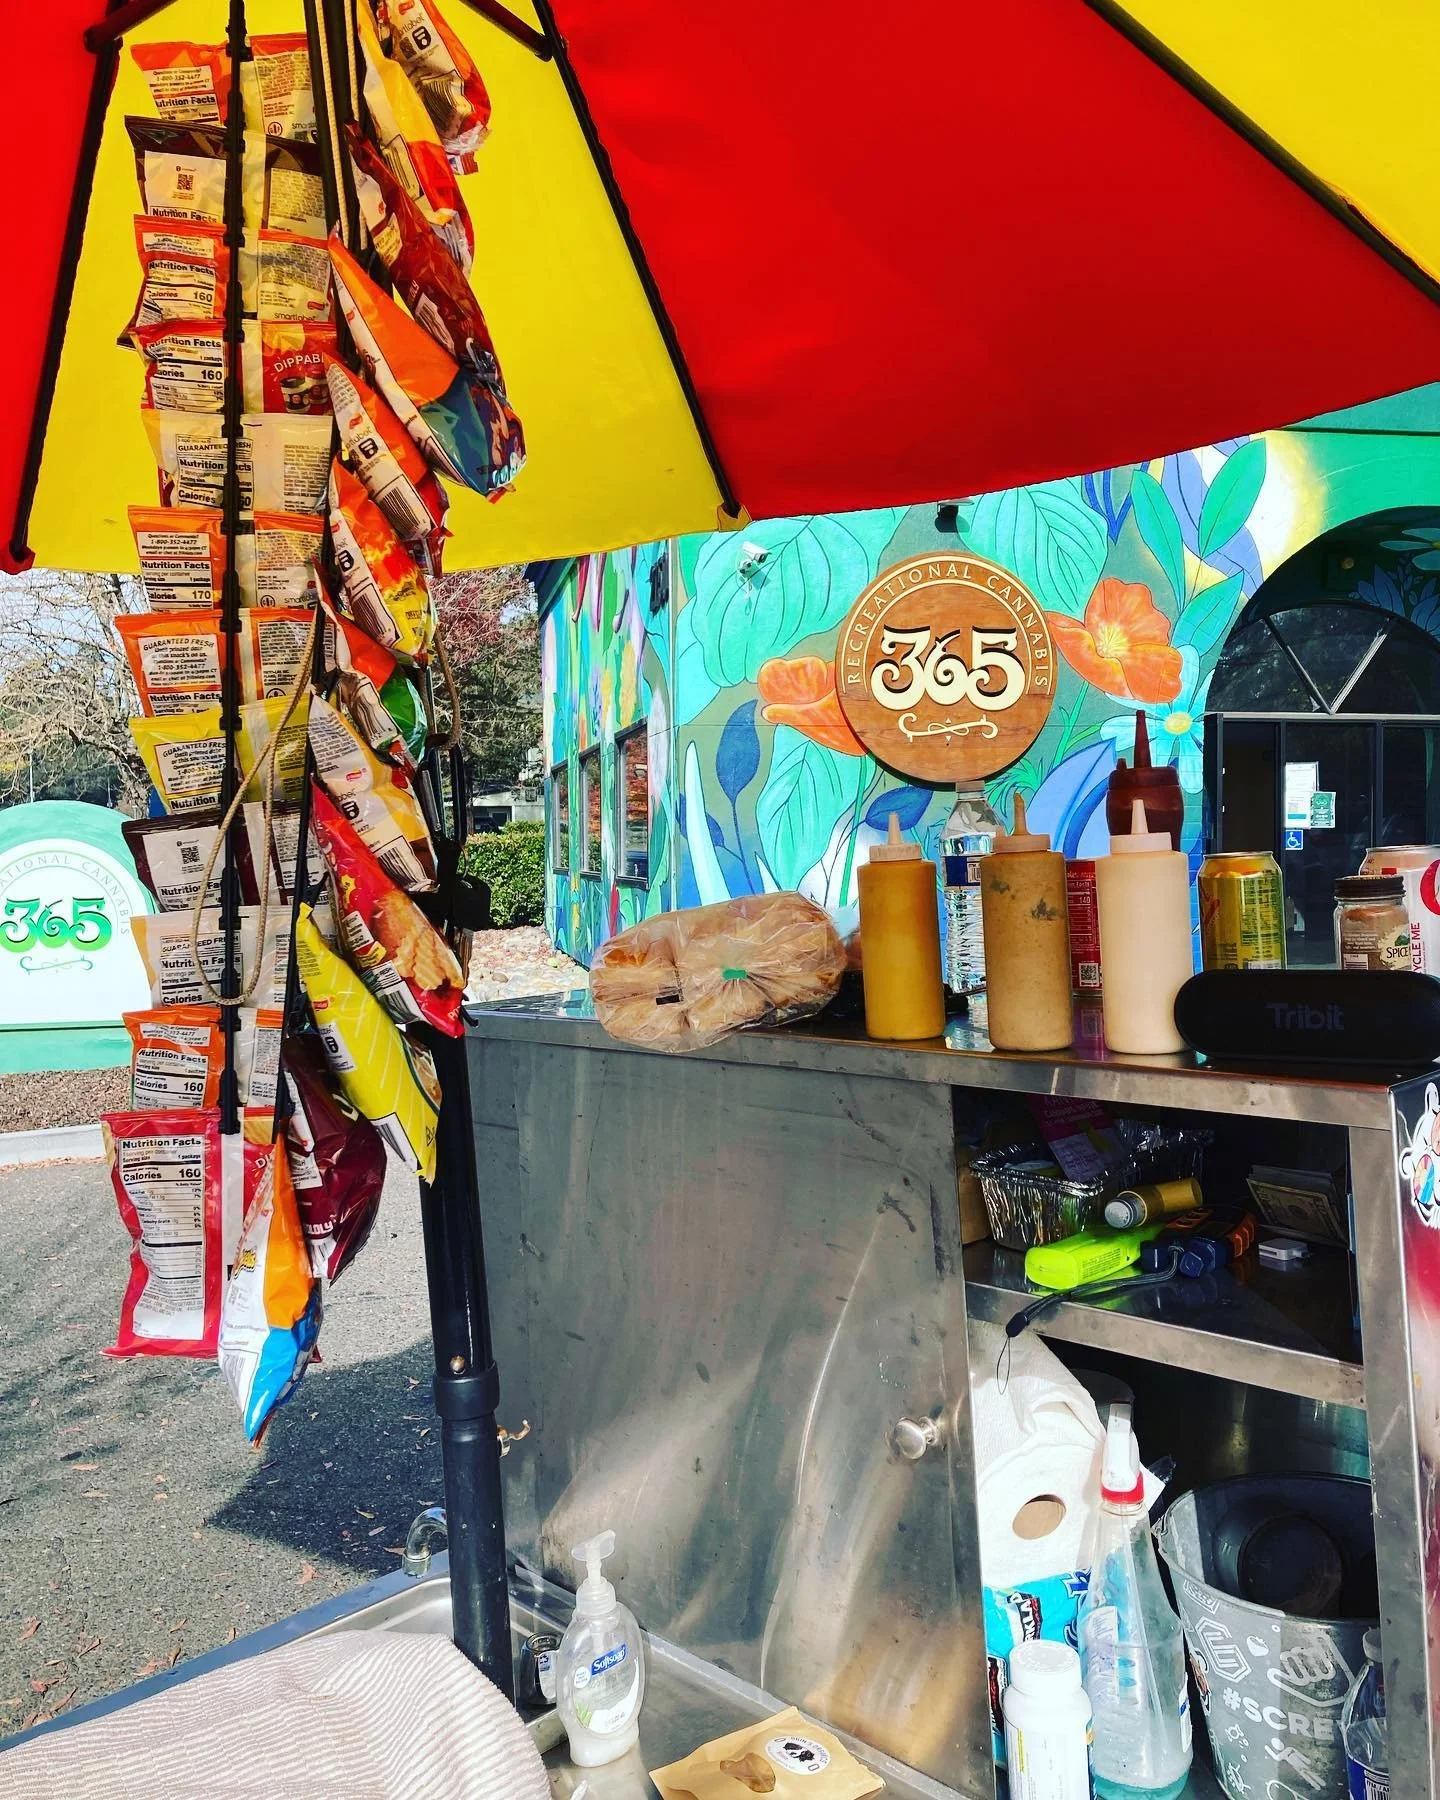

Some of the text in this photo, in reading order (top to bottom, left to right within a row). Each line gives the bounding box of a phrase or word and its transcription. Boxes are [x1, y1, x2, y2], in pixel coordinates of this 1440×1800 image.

[156, 96, 215, 107] utrition Facts
[152, 208, 187, 218] Nutrition
[149, 261, 214, 275] Nutrition Facts
[193, 291, 213, 302] 160
[194, 339, 221, 347] Facts
[274, 353, 324, 372] DIPPAB
[201, 370, 222, 380] 160
[180, 459, 224, 469] Nutrition
[179, 490, 216, 503] Calories
[192, 591, 211, 599] 170
[847, 562, 1049, 687] RECREATIONAL CANNABIS
[143, 639, 214, 651] GUARANTEED FRESH
[870, 624, 1026, 711] 365
[150, 694, 191, 702] Nutrition
[171, 796, 216, 809] Nutrition
[0, 854, 129, 935] ATIONAL CANNABIS
[161, 884, 200, 896] Nutritio
[0, 897, 112, 953] 365
[214, 935, 238, 943] FRH
[1411, 922, 1421, 973] YCLE ME
[161, 955, 241, 968] Nutritin Fas
[163, 994, 202, 1005] Calories
[1266, 1002, 1345, 1031] Tribit
[139, 1050, 206, 1063] Nutrition Facts
[136, 1078, 203, 1092] Calories 160
[123, 1140, 169, 1149] Nutrition
[123, 1168, 201, 1182] Calories 160
[593, 1649, 625, 1671] Softsoap
